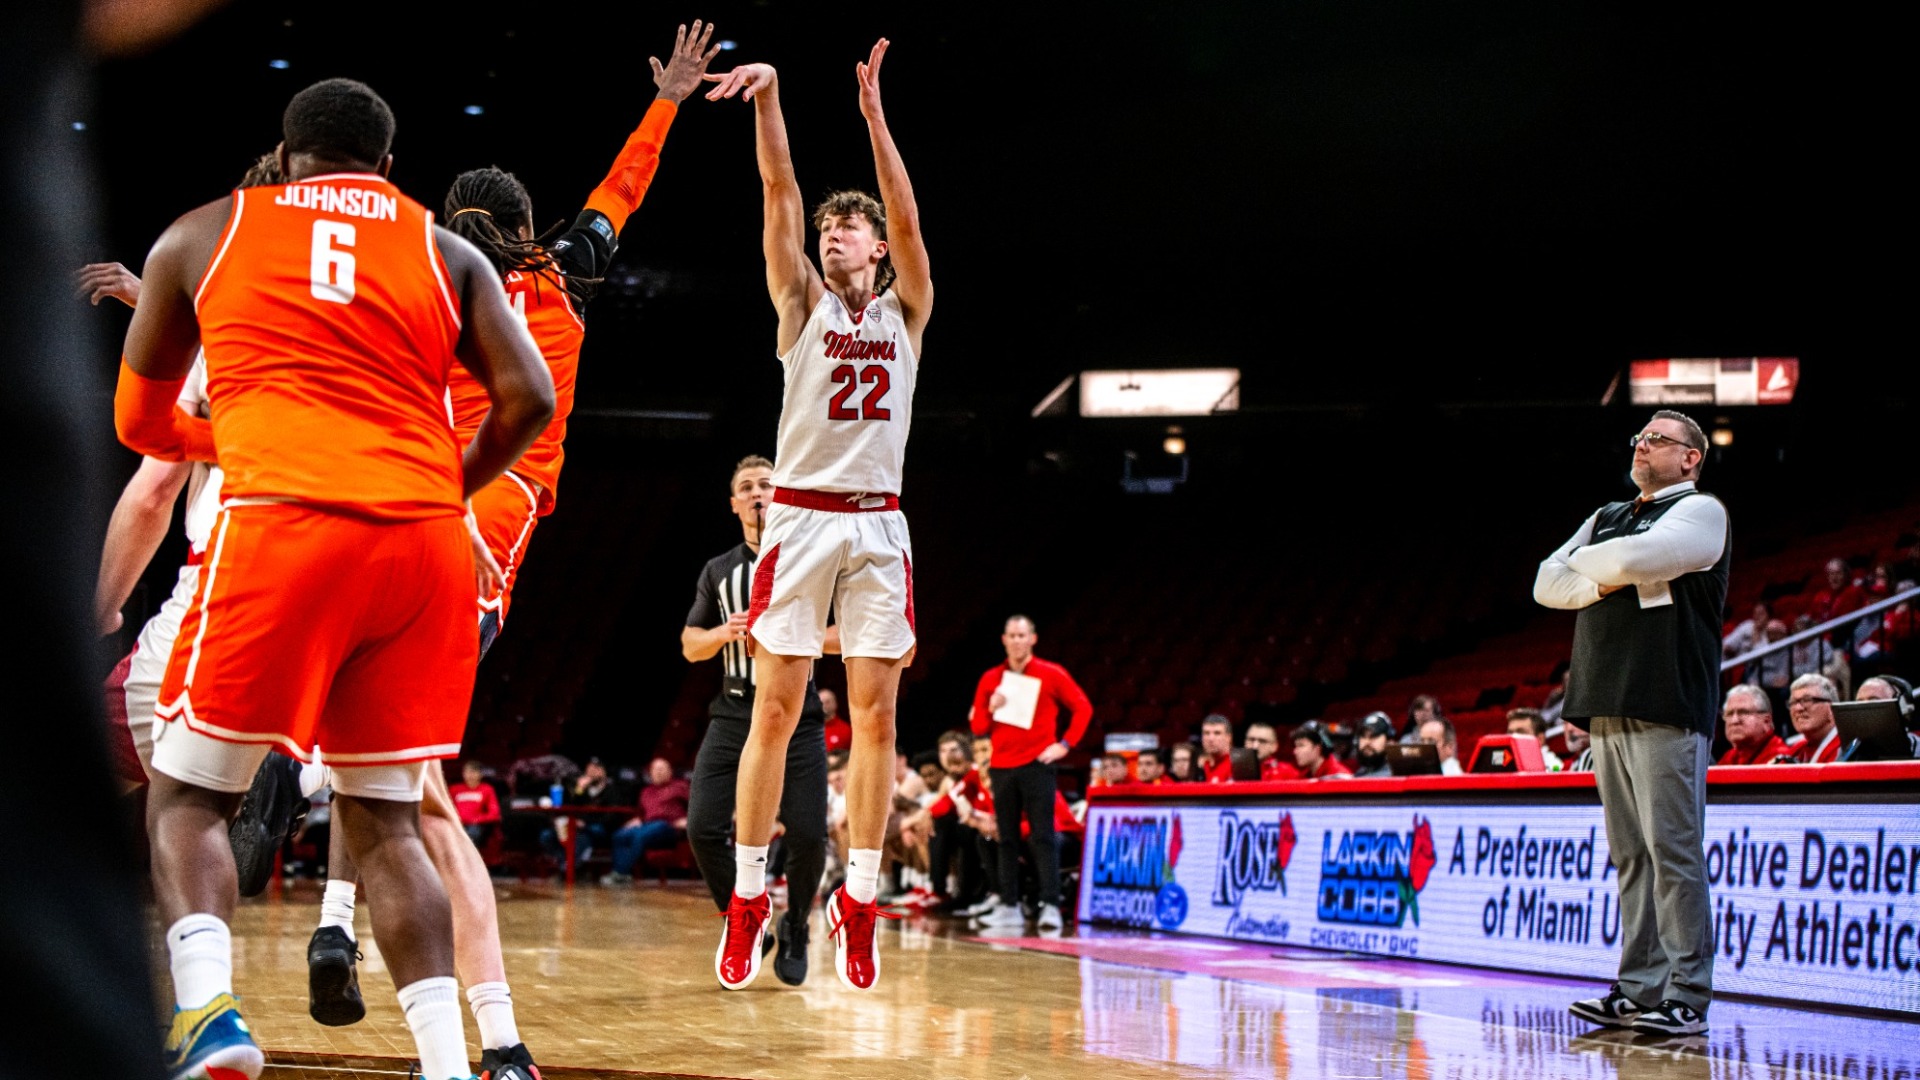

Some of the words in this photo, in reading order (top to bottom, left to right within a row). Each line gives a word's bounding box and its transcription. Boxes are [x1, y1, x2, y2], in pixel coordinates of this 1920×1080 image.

[275, 185, 397, 222] JOHNSON
[310, 219, 356, 304] 6
[823, 329, 897, 362] Miami
[828, 364, 891, 421] 22
[1093, 816, 1167, 886] LARKIN
[1212, 810, 1281, 907] ROSE
[1320, 830, 1414, 879] LARKIN
[1449, 826, 1466, 875] A
[1475, 824, 1596, 880] Preferred
[1800, 828, 1920, 895] Dealer
[1318, 879, 1401, 926] COBB
[1482, 885, 1510, 937] of
[1515, 887, 1593, 944] Miami
